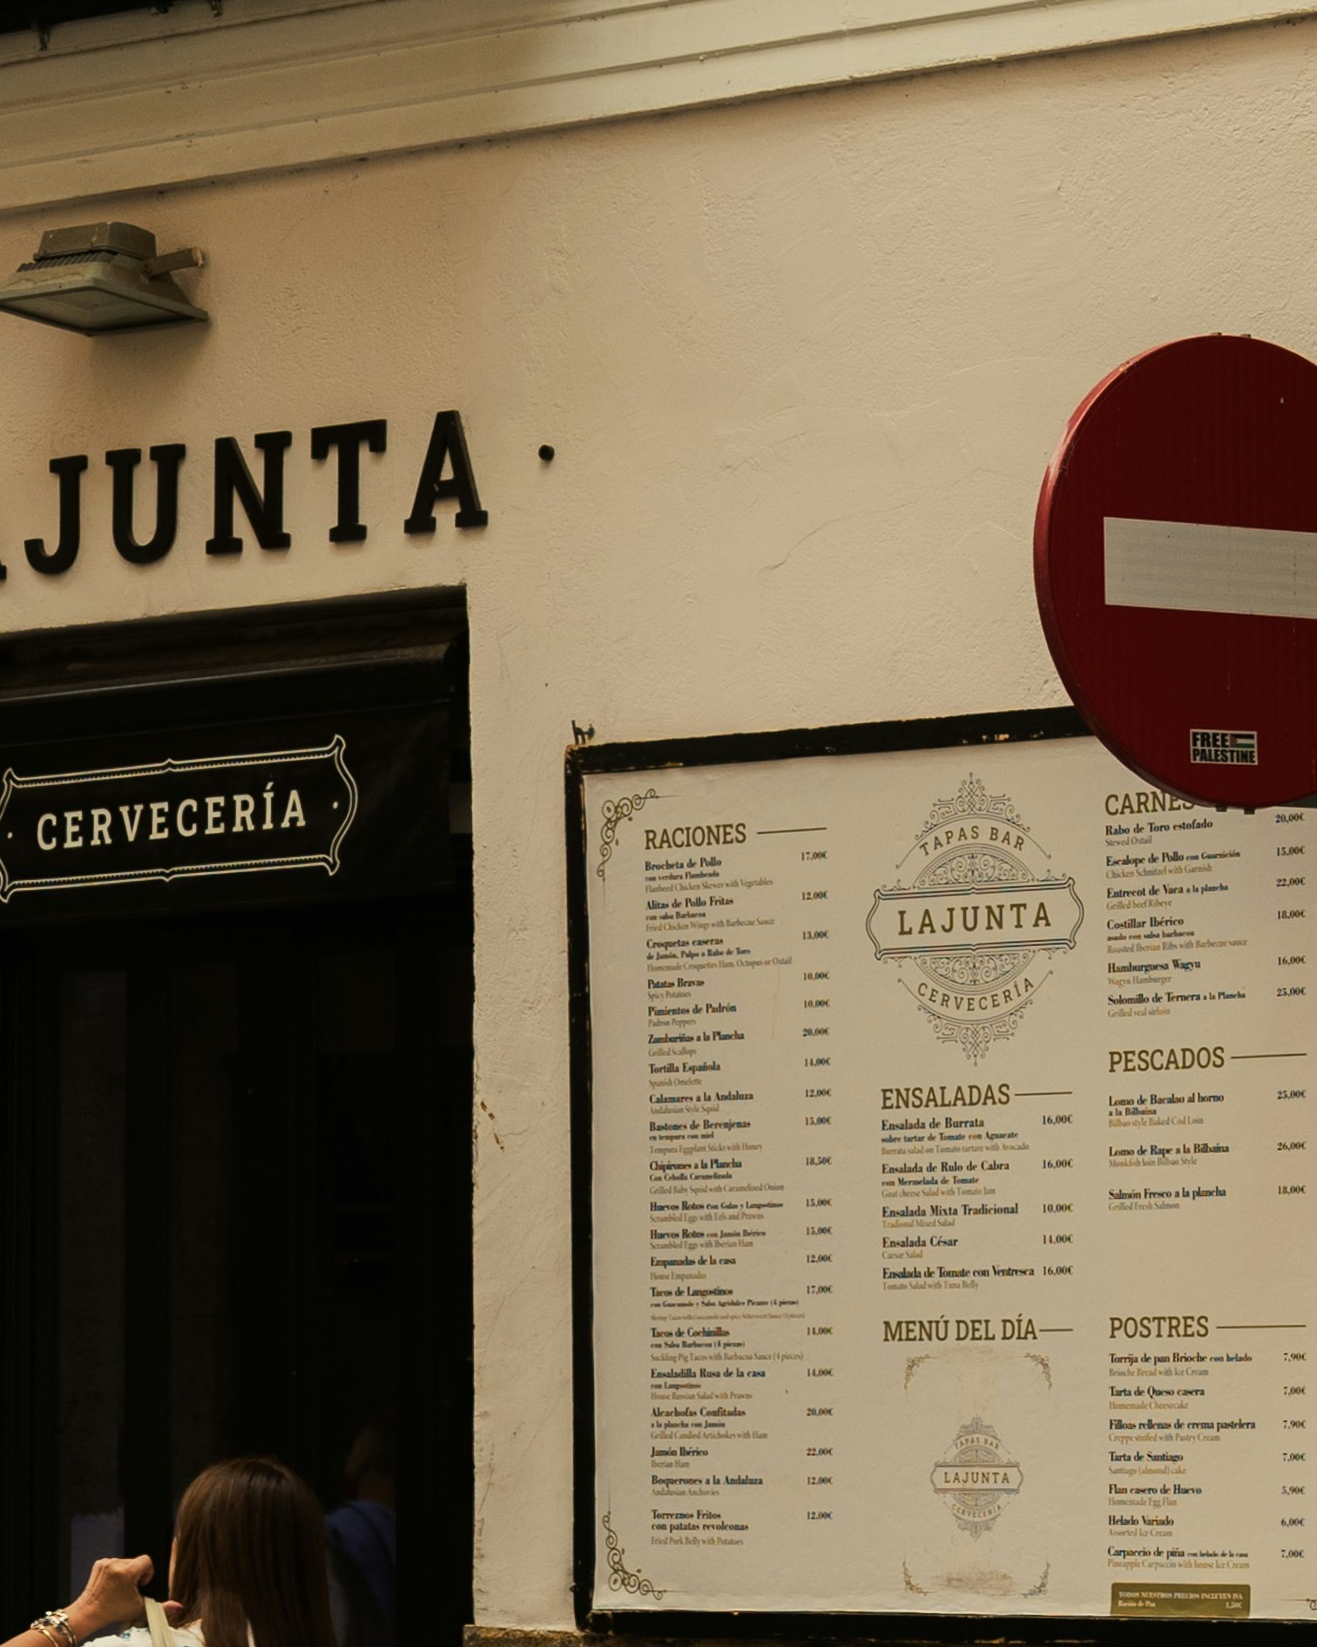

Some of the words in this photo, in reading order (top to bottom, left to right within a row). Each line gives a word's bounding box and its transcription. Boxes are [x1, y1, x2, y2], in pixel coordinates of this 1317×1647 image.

[1192, 732, 1230, 749] FREE
[1192, 748, 1256, 765] PALESTINE
[36, 782, 307, 853] CERVECERÍA
[1106, 824, 1130, 835] Rabo
[1133, 823, 1144, 833] de
[1150, 822, 1169, 832] Toro
[1173, 818, 1213, 830] estofado
[645, 822, 746, 849] RACIONES
[919, 825, 980, 857] TAPAS
[989, 827, 1026, 852] BAR
[645, 860, 684, 871] Brocheta
[686, 858, 696, 868] de
[700, 856, 721, 867] Pollo
[1106, 855, 1145, 867] Escalope
[1148, 853, 1158, 863] de
[1162, 851, 1187, 862] Pollo
[1107, 887, 1145, 898] Entrecot
[1148, 885, 1159, 895] de
[1163, 884, 1183, 894] Vaca
[646, 900, 669, 909] Alitas
[671, 898, 681, 908] de
[685, 897, 706, 907] Pollo
[709, 896, 733, 906] Fritas
[898, 902, 1050, 935] LAJUNTA
[1107, 918, 1146, 929] Costillar
[1150, 916, 1183, 927] Ibérico
[646, 939, 689, 950] Croquetas
[1108, 962, 1168, 973] Hamburguesa
[1172, 959, 1200, 971] Wagyu
[647, 979, 674, 989] Patatas
[677, 978, 704, 987] Bravas
[918, 976, 1035, 1012] CERVECERÍA
[1108, 993, 1149, 1005] Solomillo
[1151, 992, 1162, 1002] de
[1167, 992, 1200, 1002] Ternera
[648, 1006, 689, 1016] Pimientos
[692, 1004, 702, 1014] de
[706, 1002, 736, 1013] Padrón
[1109, 1046, 1224, 1072] PESCADOS
[650, 1063, 679, 1073] Tortilla
[682, 1061, 720, 1074] Española
[881, 1083, 1009, 1109] ENSALADAS
[1109, 1095, 1134, 1106] Lomo
[1136, 1094, 1147, 1105] de
[1150, 1093, 1184, 1104] Bacalao
[1187, 1092, 1194, 1102] al
[1197, 1092, 1224, 1102] horno
[649, 1121, 687, 1131] Bastones
[689, 1120, 700, 1130] de
[703, 1119, 750, 1131] Berenjenas
[882, 1118, 925, 1130] Ensalada
[929, 1117, 940, 1128] de
[945, 1117, 984, 1128] Burrata
[882, 1162, 922, 1173] Ensalada
[926, 1162, 937, 1172] de
[941, 1161, 963, 1172] Rulo
[966, 1160, 977, 1170] de
[981, 1160, 1009, 1170] Cabra
[882, 1205, 926, 1217] Ensalada
[930, 1205, 957, 1216] Mixta
[963, 1202, 1018, 1215] Tradicional
[882, 1236, 926, 1247] Ensalada
[930, 1235, 958, 1246] César
[883, 1267, 921, 1279] Ensalada
[923, 1267, 935, 1277] de
[939, 1266, 970, 1277] Tomate
[992, 1265, 1034, 1276] Ventresca
[883, 1315, 949, 1341] MENÚ
[955, 1319, 995, 1340] DEL
[1001, 1314, 1037, 1340] DÍA
[1109, 1315, 1208, 1338] POSTRES
[1111, 1353, 1138, 1366] Torrija
[1140, 1353, 1151, 1362] de
[1153, 1356, 1169, 1366] pan
[1172, 1352, 1207, 1362] Brioche
[1111, 1386, 1131, 1396] Tarta
[1133, 1386, 1144, 1396] de
[1147, 1386, 1174, 1398] Queso
[652, 1407, 697, 1417] Alcachofas
[700, 1406, 745, 1416] Confitadas
[650, 1446, 677, 1457] Jamón
[679, 1446, 708, 1456] Ibérico
[944, 1471, 1009, 1483] LAJUNTA
[1109, 1483, 1127, 1494] Flan
[1159, 1484, 1170, 1494] de
[1173, 1484, 1201, 1494] Huevo
[653, 1509, 694, 1519] Torreznos
[697, 1509, 721, 1519] Fritos
[1108, 1515, 1138, 1525] Helado
[1142, 1515, 1173, 1525] Variado
[669, 1522, 699, 1533] patatas
[702, 1520, 748, 1530] revolconas
